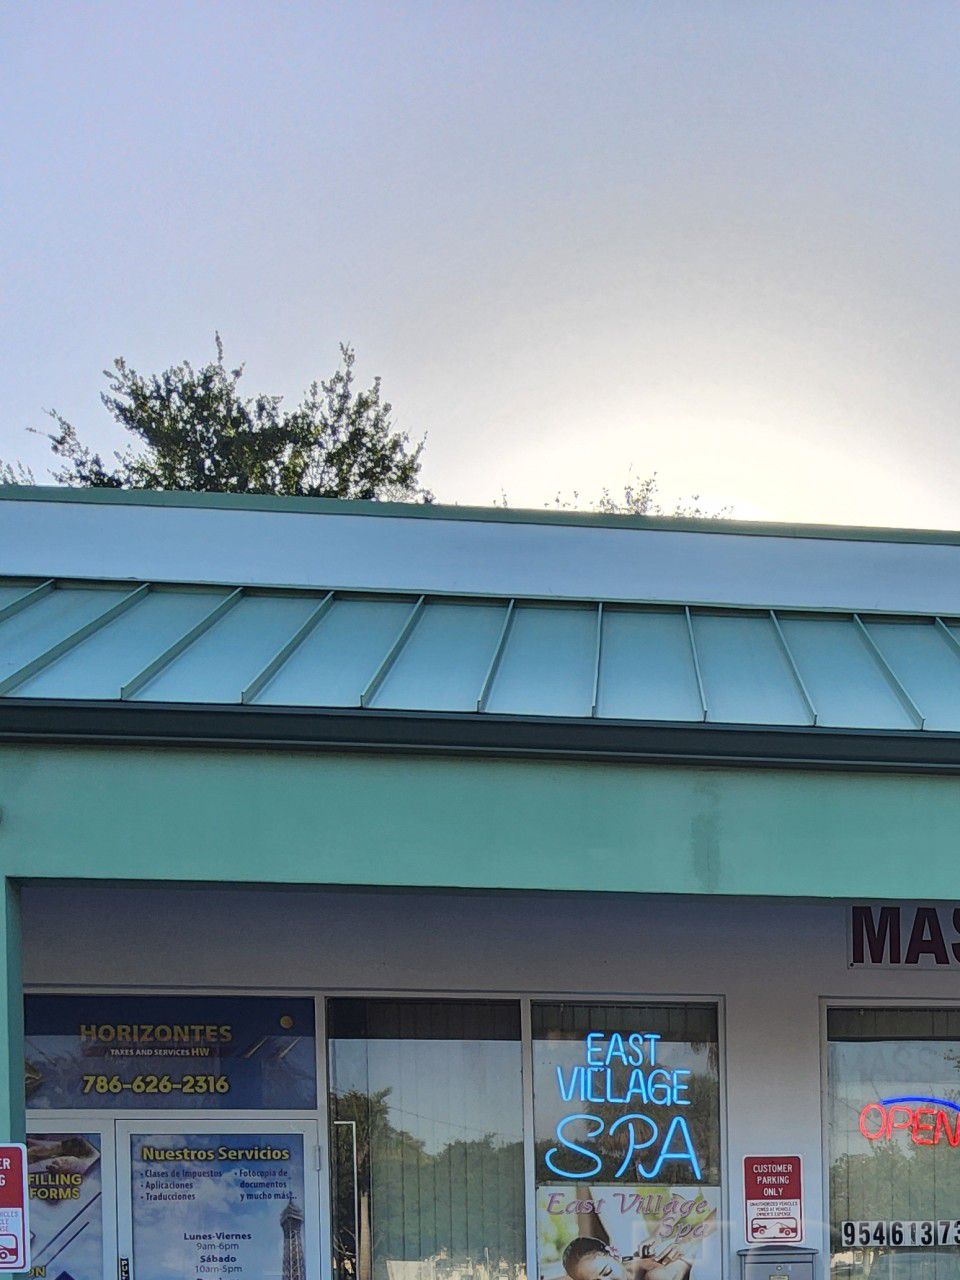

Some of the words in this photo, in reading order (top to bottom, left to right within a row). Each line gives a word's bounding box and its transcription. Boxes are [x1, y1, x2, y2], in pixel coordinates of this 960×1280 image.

[80, 1024, 233, 1043] HORIZONTES
[110, 1048, 134, 1056] TAXES
[136, 1048, 152, 1056] AND
[154, 1048, 190, 1056] SERVICES
[586, 1032, 661, 1067] EAST
[83, 1075, 230, 1094] 786-626-2316
[555, 1066, 692, 1106] VILLAGE
[544, 1113, 702, 1180] SPA
[142, 1146, 215, 1161] Nuestros
[218, 1146, 290, 1161] Servicios
[278, 1168, 288, 1177] de
[752, 1164, 793, 1173] CUSTOMER
[170, 1169, 180, 1178] de
[182, 1170, 222, 1179] Impuestos
[28, 1173, 82, 1186] FILLING
[240, 1180, 287, 1189] documentos
[756, 1175, 790, 1185] PARKING
[145, 1180, 193, 1190] Aplicaciones
[29, 1187, 80, 1199] FORMS
[763, 1187, 784, 1196] ONLY
[546, 1192, 606, 1215] East
[612, 1192, 710, 1219] Village
[659, 1216, 710, 1244] Spa
[183, 1232, 252, 1241] Lunes-Viernes
[196, 1242, 240, 1251] 9am-6pm
[200, 1254, 237, 1263] Sábado
[194, 1264, 243, 1274] 10am-5pm
